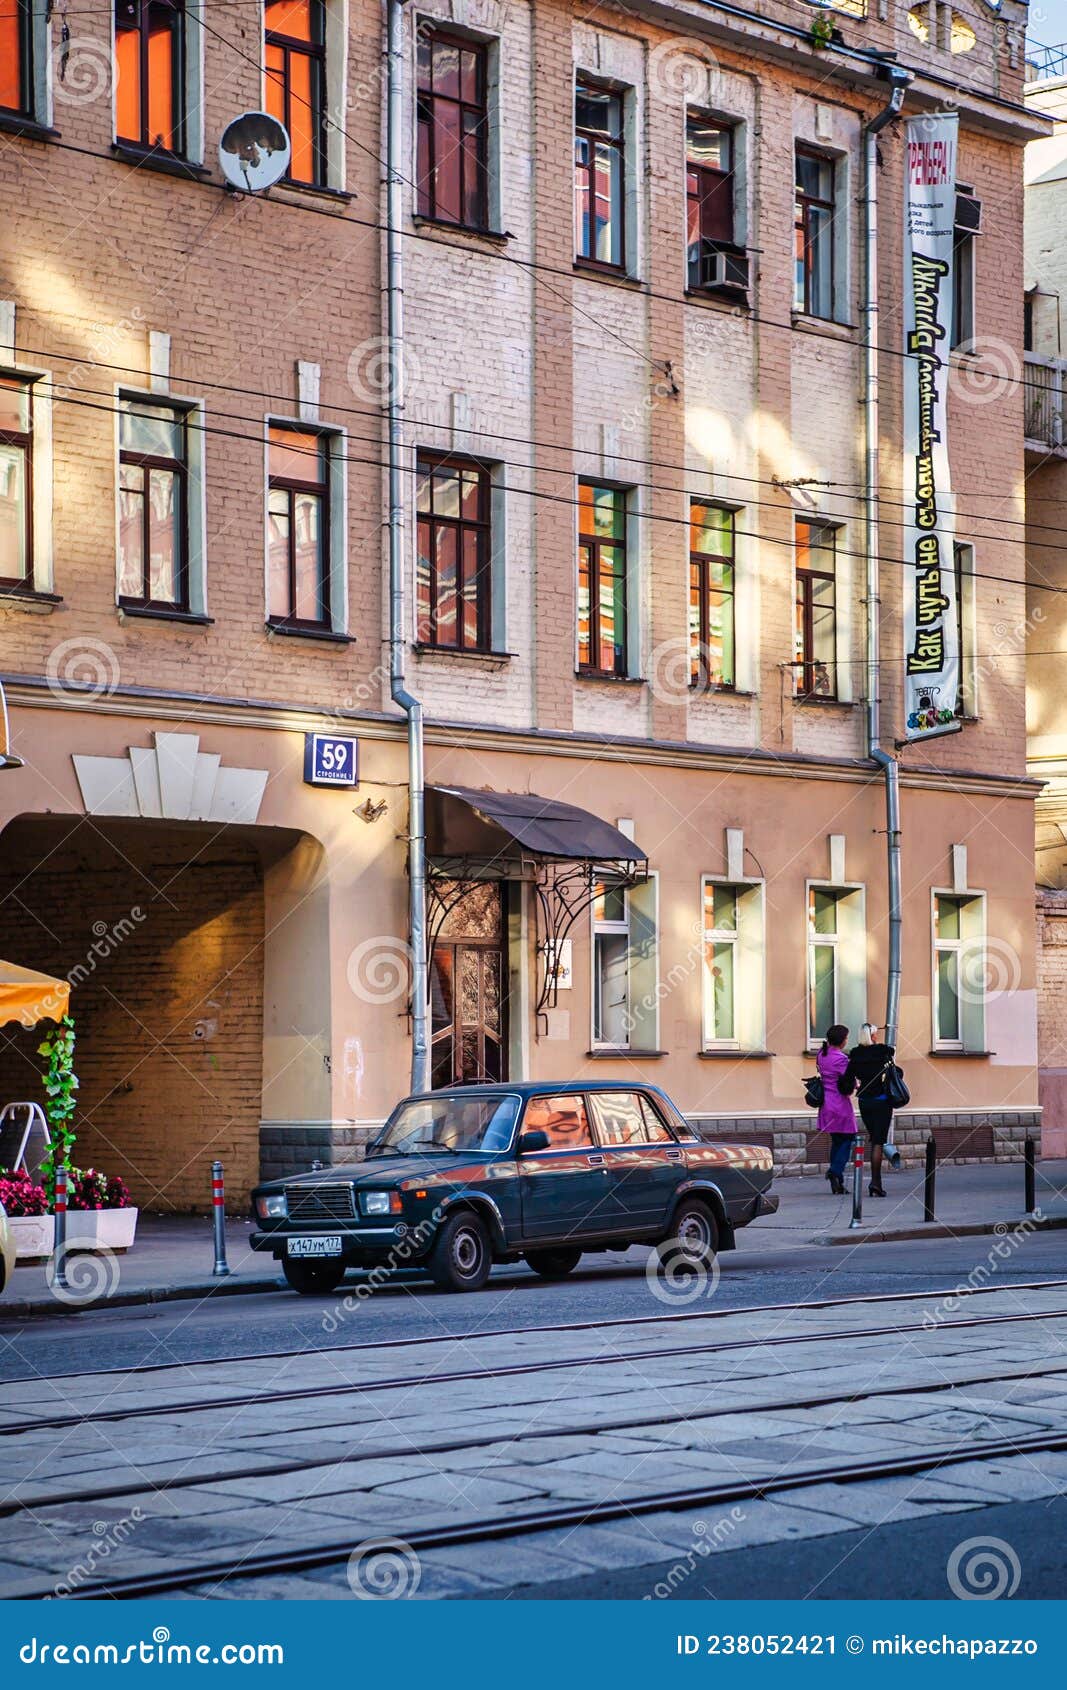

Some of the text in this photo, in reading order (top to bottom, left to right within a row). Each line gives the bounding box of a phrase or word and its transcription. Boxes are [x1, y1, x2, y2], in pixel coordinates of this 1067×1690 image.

[910, 256, 946, 349] Булочку
[918, 538, 937, 564] не
[918, 570, 946, 621] чуть
[909, 632, 942, 670] Как
[322, 743, 348, 770] 59
[325, 1237, 339, 1248] 177
